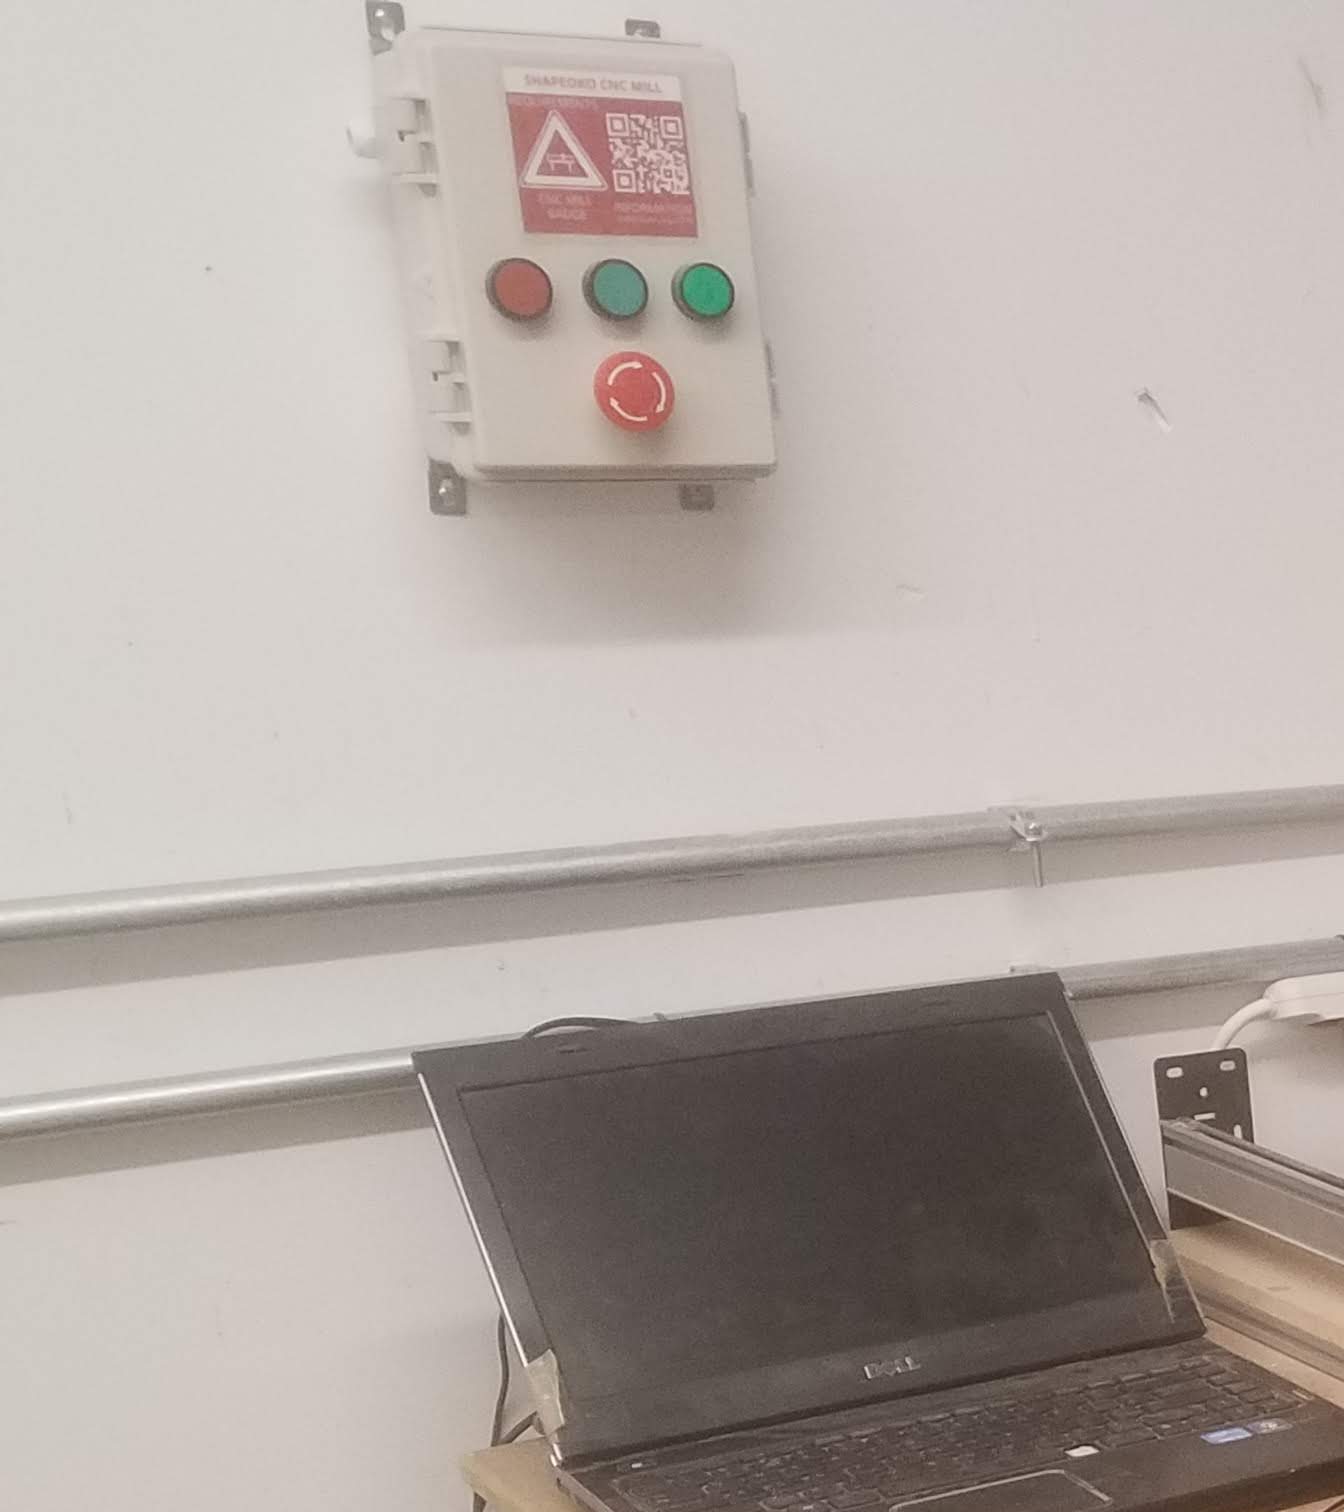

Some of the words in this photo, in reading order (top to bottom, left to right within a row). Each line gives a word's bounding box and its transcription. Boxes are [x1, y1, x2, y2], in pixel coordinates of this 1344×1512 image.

[600, 78, 626, 91] CNC
[631, 80, 663, 93] MILL
[864, 1356, 921, 1379] DELL
